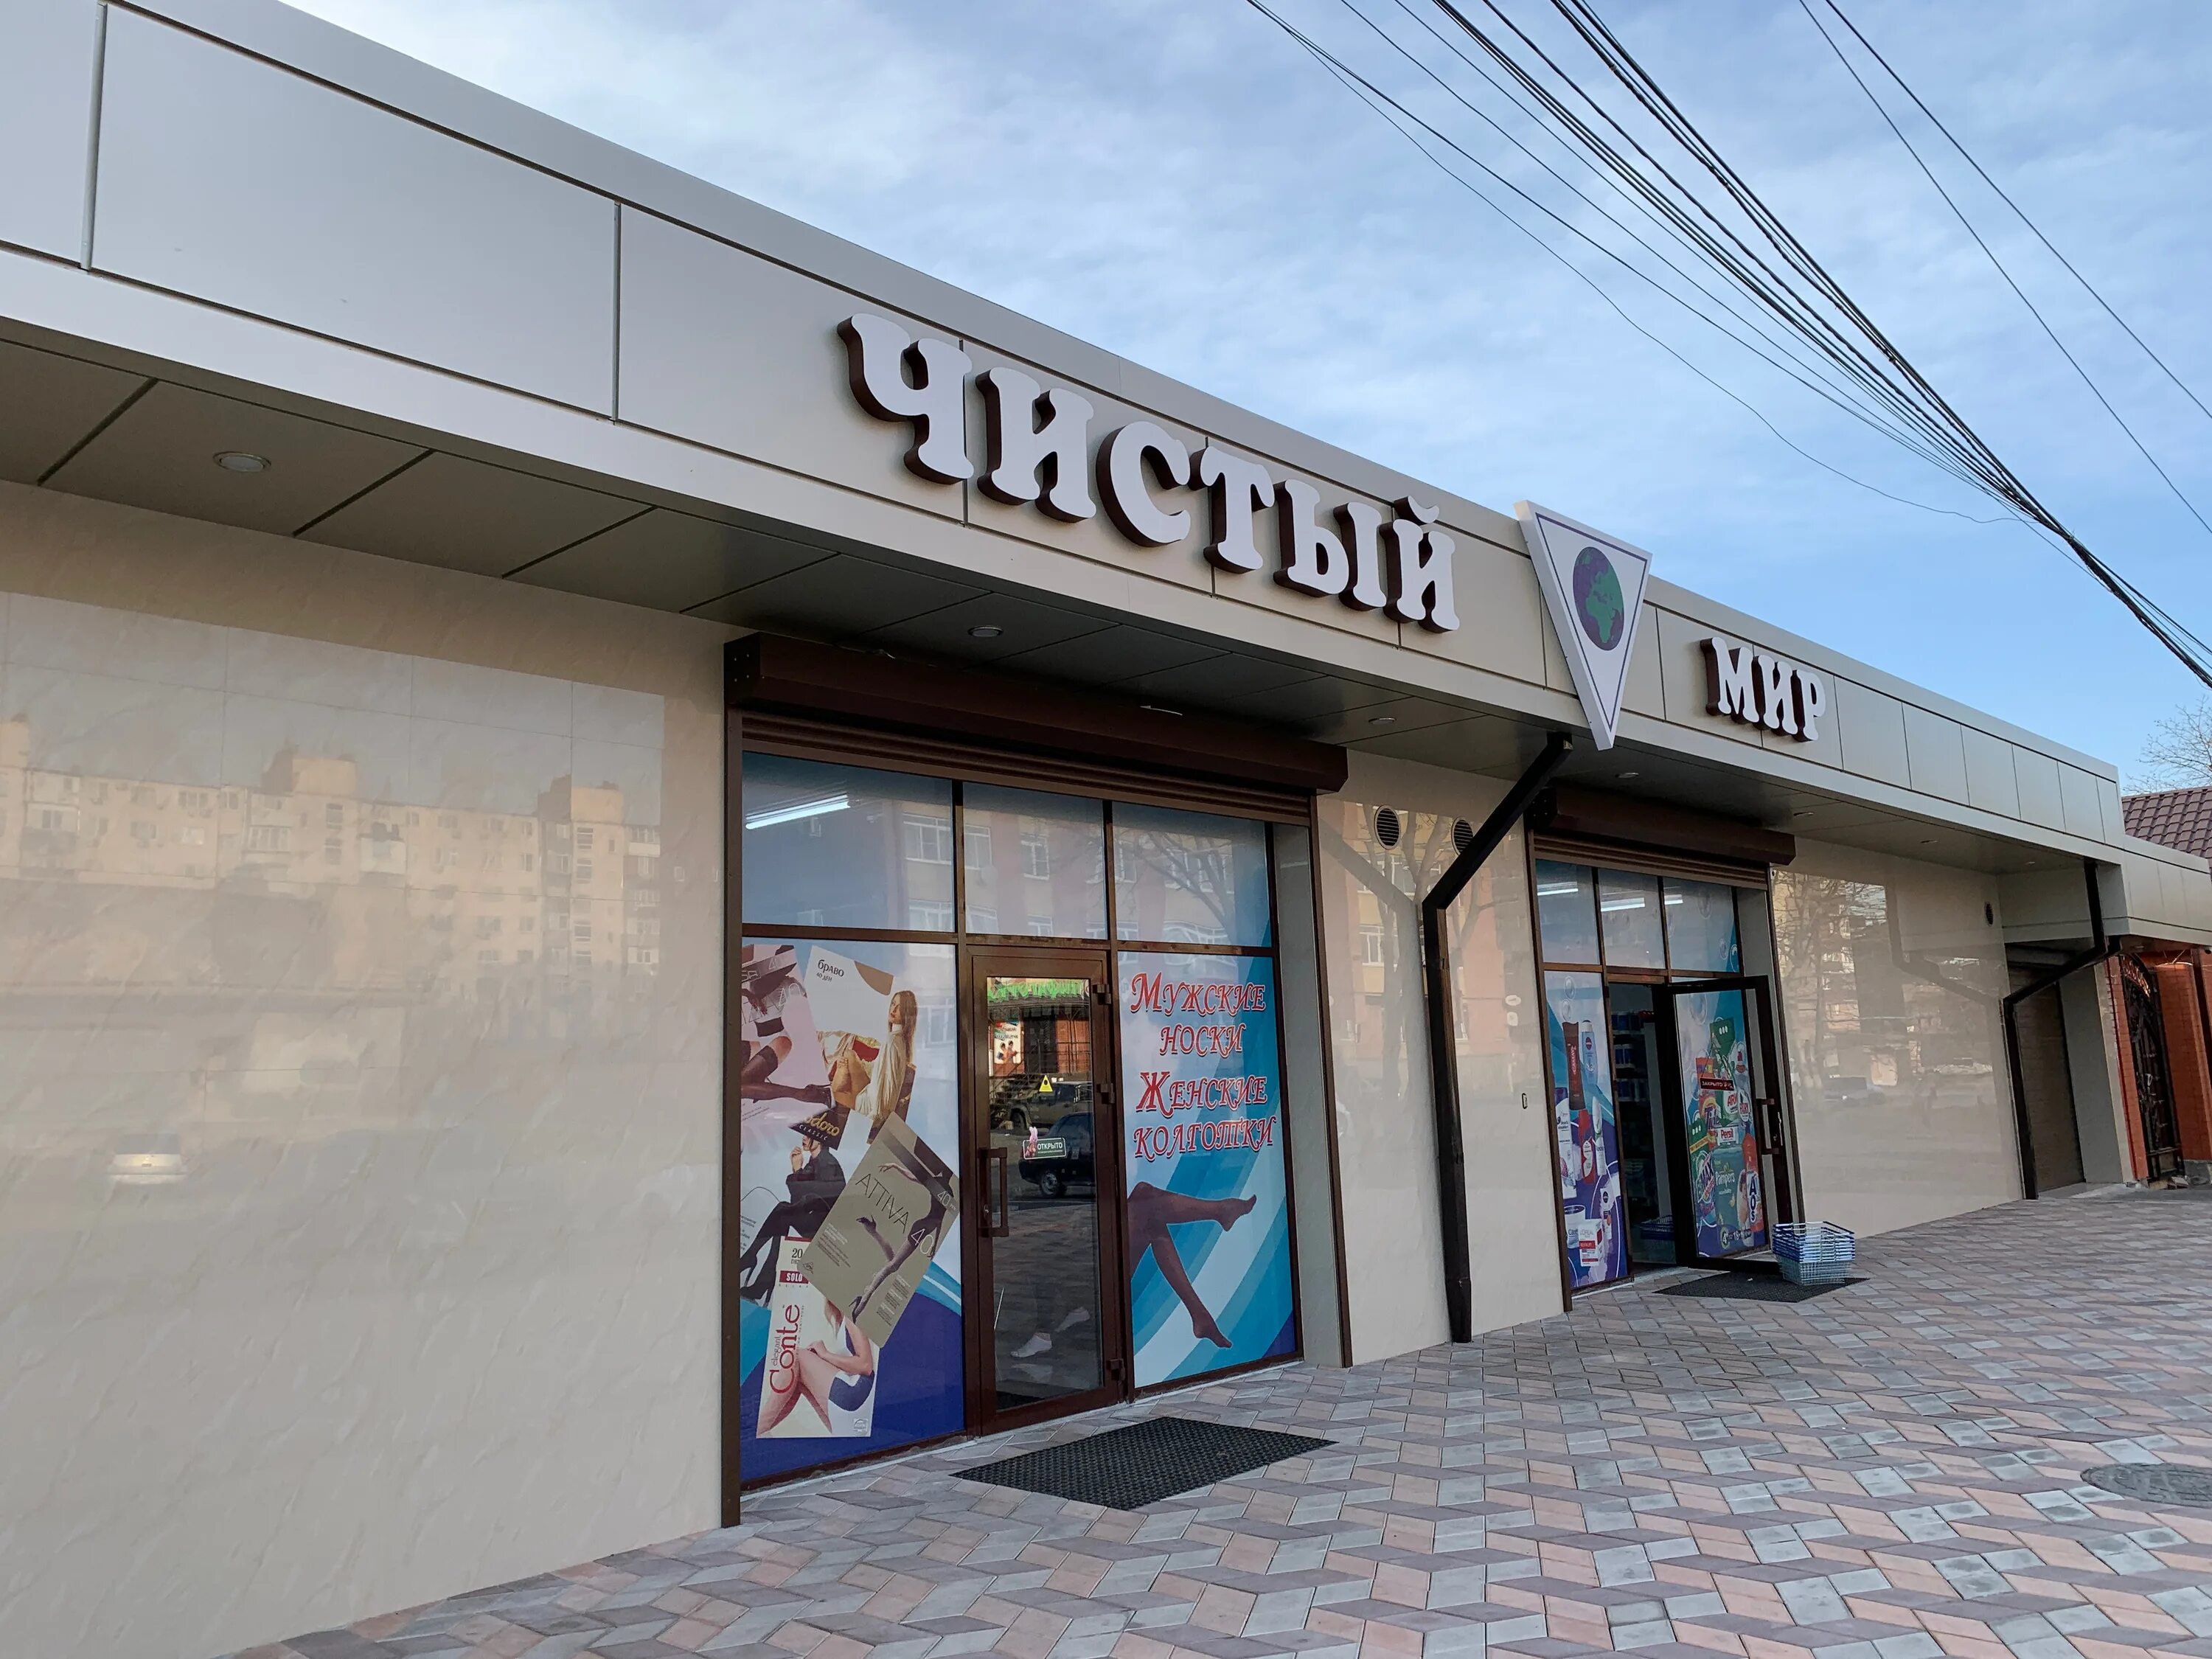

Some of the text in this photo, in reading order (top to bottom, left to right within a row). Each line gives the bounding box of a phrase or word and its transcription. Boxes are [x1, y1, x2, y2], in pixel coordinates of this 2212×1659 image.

[837, 313, 1826, 742] ЧИСТЫЙ МИР
[1160, 1023, 1247, 1057] НОСКИ
[799, 1124, 828, 1141] CLASSIC
[1133, 1116, 1277, 1161] КОЛГОТКИ
[1037, 1142, 1062, 1150] ОТКРЫТО
[1715, 1171, 1736, 1188] Pampers
[855, 1173, 909, 1234] ATTIVA
[937, 1190, 951, 1206] 40
[1749, 1175, 1757, 1221] AOS
[791, 1248, 803, 1259] 20
[911, 1228, 934, 1254] 40
[786, 1273, 803, 1282] SOLO
[769, 1304, 800, 1394] Conte
